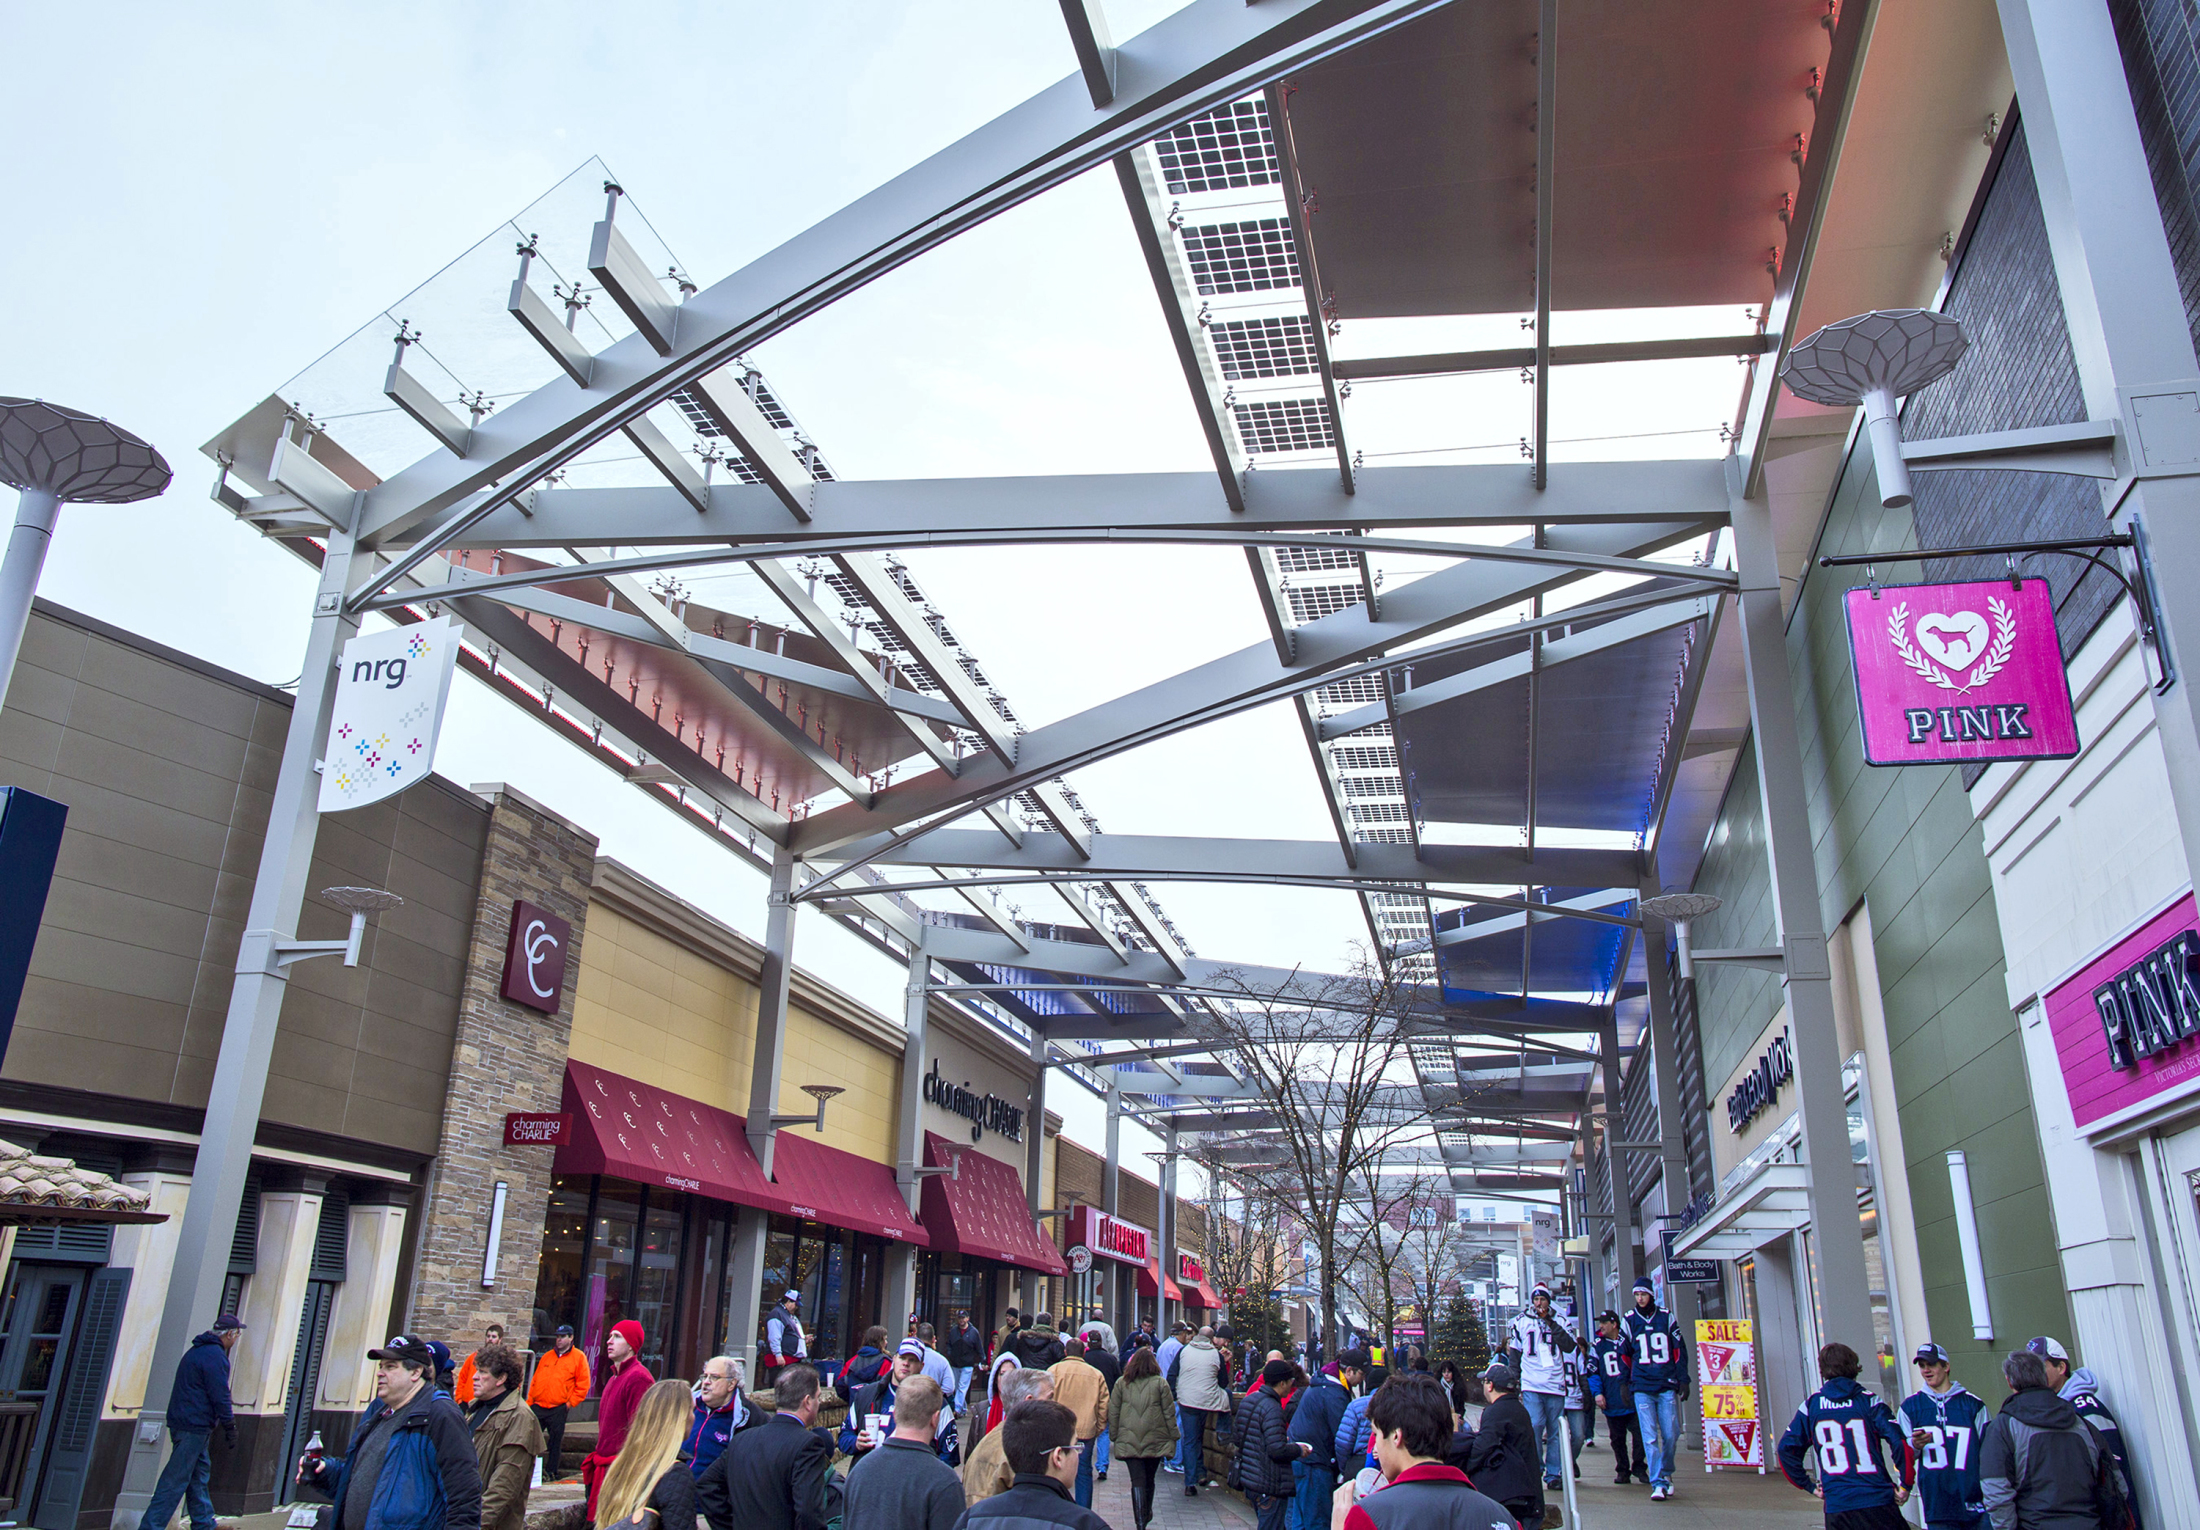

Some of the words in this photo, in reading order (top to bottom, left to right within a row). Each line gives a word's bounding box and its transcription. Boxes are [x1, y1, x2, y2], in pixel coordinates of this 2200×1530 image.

[352, 658, 407, 690] nrg
[1904, 703, 2033, 743] PINK
[2092, 929, 2200, 1072] PINK
[512, 1116, 561, 1134] charming
[512, 1129, 553, 1141] CHARLIE
[1535, 1218, 1550, 1228] nrg
[1669, 1262, 1686, 1270] Bath
[1687, 1261, 1693, 1269] &
[1694, 1260, 1714, 1269] Body
[1680, 1270, 1705, 1278] Works
[1708, 1325, 1740, 1341] SALE
[1635, 1333, 1670, 1364] 19
[1709, 1353, 1720, 1369] $3
[2073, 1395, 2099, 1409] 54
[1734, 1434, 1747, 1449] $4
[1815, 1419, 1878, 1475] 81
